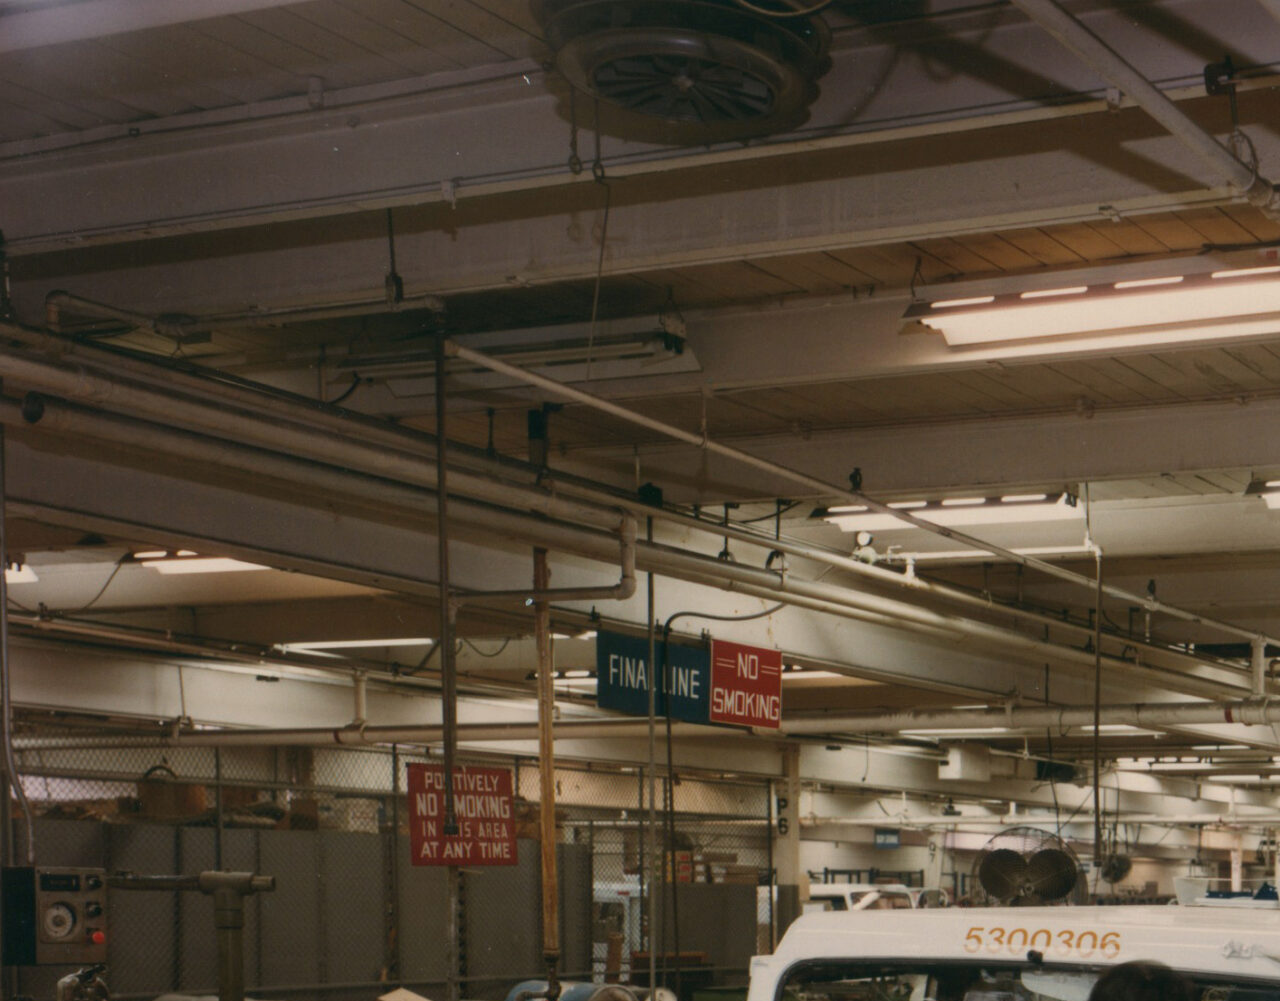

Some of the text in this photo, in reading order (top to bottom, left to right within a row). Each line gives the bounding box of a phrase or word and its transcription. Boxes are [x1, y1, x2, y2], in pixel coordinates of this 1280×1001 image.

[737, 652, 758, 680] NO
[662, 664, 700, 699] LINE
[712, 687, 780, 721] SMOKING
[424, 771, 499, 793] POITIVELY
[416, 792, 511, 819] NO MOKING
[422, 820, 437, 837] IN
[478, 822, 508, 839] AREA
[420, 841, 511, 859] AT ANY TIME
[963, 926, 1122, 960] 5300306
